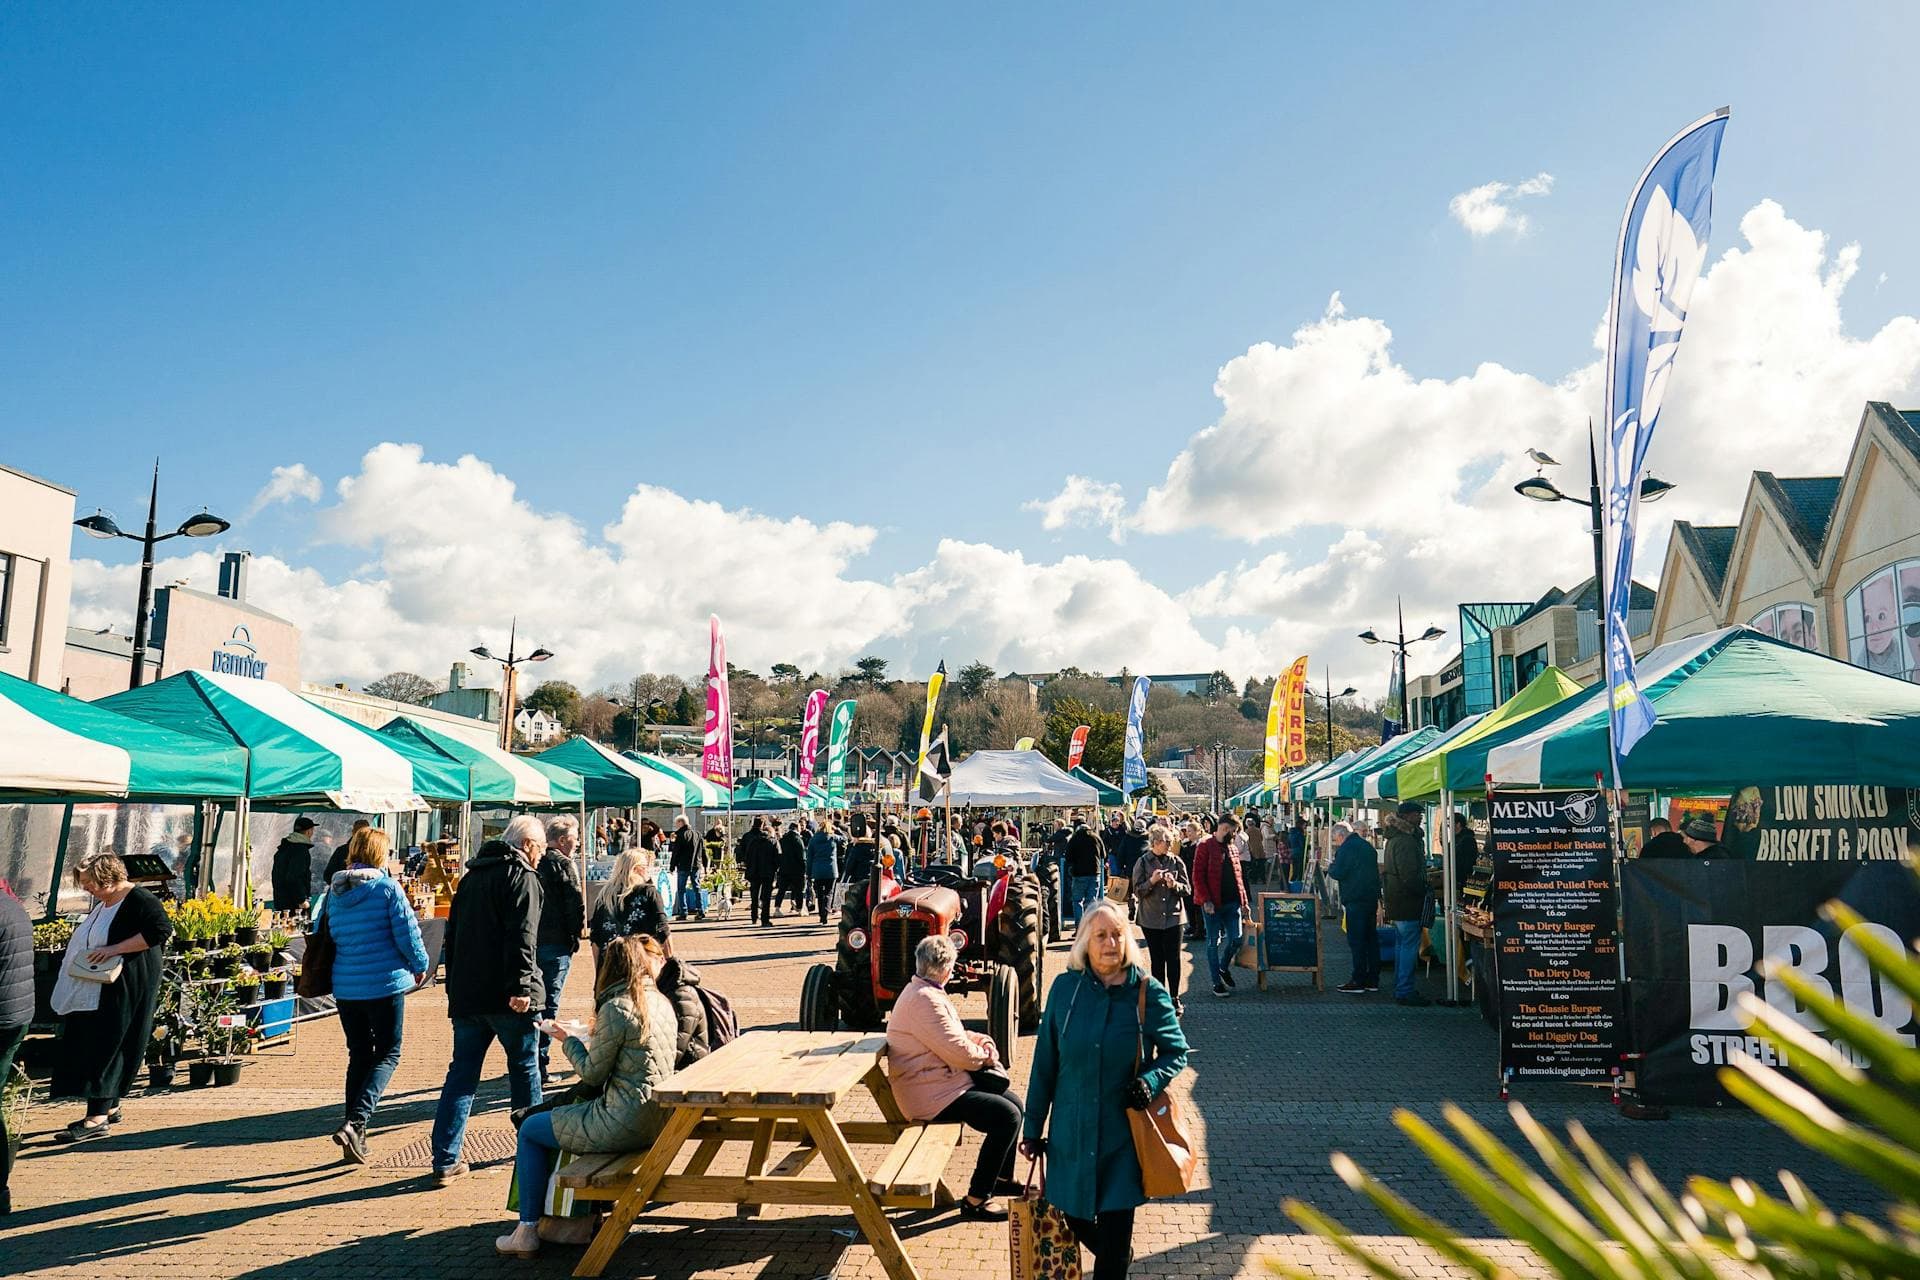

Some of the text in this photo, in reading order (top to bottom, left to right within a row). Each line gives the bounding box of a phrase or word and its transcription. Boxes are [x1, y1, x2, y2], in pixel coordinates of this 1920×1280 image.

[1290, 664, 1304, 762] CHURRO
[1774, 784, 1808, 821] LOW
[1814, 784, 1888, 819] SMOKED
[1492, 800, 1555, 819] MENU
[1496, 841, 1606, 852] BBQ Smoked Beef Brisket
[1755, 827, 1910, 861] BRISKET & PORK
[1498, 880, 1609, 890] BBQ Smoked Pulled Pork
[1518, 922, 1596, 932] The Dirty Burger
[1526, 968, 1590, 979] The Dirty Dog
[1687, 922, 1916, 1048] BBQ
[1519, 1004, 1602, 1014] The Classic Burger
[1529, 1032, 1598, 1042] Hot Diggity Dog
[1519, 1067, 1605, 1076] thesmokinglonghorn
[1012, 1211, 1023, 1246] eden
